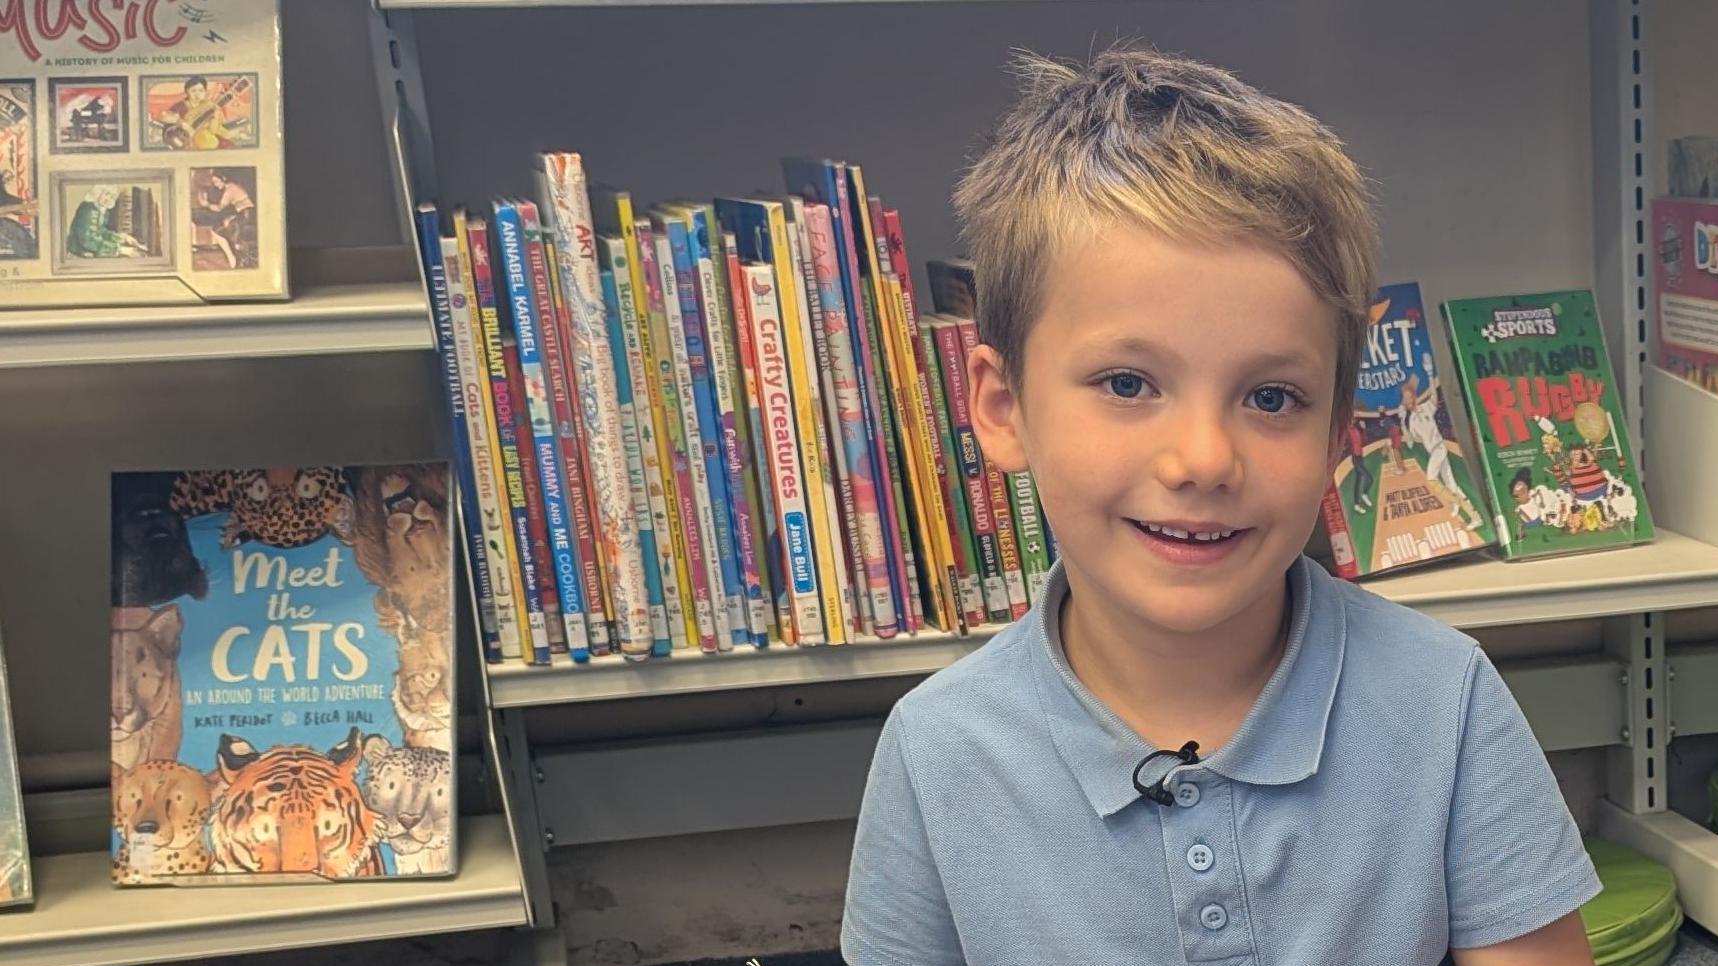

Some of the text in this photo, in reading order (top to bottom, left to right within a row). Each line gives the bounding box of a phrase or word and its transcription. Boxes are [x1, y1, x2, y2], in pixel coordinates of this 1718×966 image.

[54, 58, 98, 67] HISTORY
[117, 57, 149, 65] MUSIC
[174, 55, 225, 64] CHILDREN
[576, 223, 598, 295] ART ideas
[662, 263, 676, 296] Collins
[808, 229, 834, 295] FACE
[503, 219, 535, 357] ANNABEL KARMEL
[618, 282, 637, 331] Recycle
[432, 264, 465, 417] ULTIMATE FOOTBALL
[530, 248, 564, 402] THE GREAT CASTLE SEARCH
[627, 333, 636, 348] AND
[703, 271, 731, 401] Clever Crafts for Little Fingers
[1497, 319, 1557, 339] SPORTS
[482, 306, 505, 380] BRILLIANT
[494, 381, 513, 427] BOOK
[630, 350, 646, 396] REMAKE
[679, 368, 694, 407] nature
[902, 291, 918, 337] ULTIMATE
[918, 372, 933, 415] WOMEN'S
[926, 416, 942, 460] FOOTBALL
[944, 333, 968, 423] THE GOAT
[466, 382, 483, 418] Cats
[595, 344, 628, 503] Big book of things to draw
[757, 318, 801, 499] Crafty Creatures
[1476, 371, 1605, 448] RUGBY
[472, 422, 481, 441] and
[686, 411, 699, 438] craft
[475, 444, 495, 499] Kittens
[724, 427, 742, 474] Fun with
[960, 431, 990, 531] MESSI RONALDO
[989, 471, 1000, 482] OF
[991, 487, 1004, 504] THE
[540, 442, 578, 614] MUMMY AND ME COOKBO
[1013, 471, 1041, 539] FOOTBALL
[517, 516, 532, 563] Susannah
[566, 458, 600, 611] JANE BINGHAM USBORNE
[745, 550, 755, 566] Lim
[790, 522, 808, 582] Jane Bull
[233, 547, 344, 594] Meet
[524, 564, 537, 591] Blake
[628, 559, 644, 605] Usborne
[267, 592, 315, 620] the
[210, 622, 369, 684] CATS
[186, 685, 385, 705] AN AROUND THE WORLD ADVENTURE
[195, 715, 225, 728] KATE
[303, 712, 341, 726] BECCA
[346, 711, 374, 725] HALL
